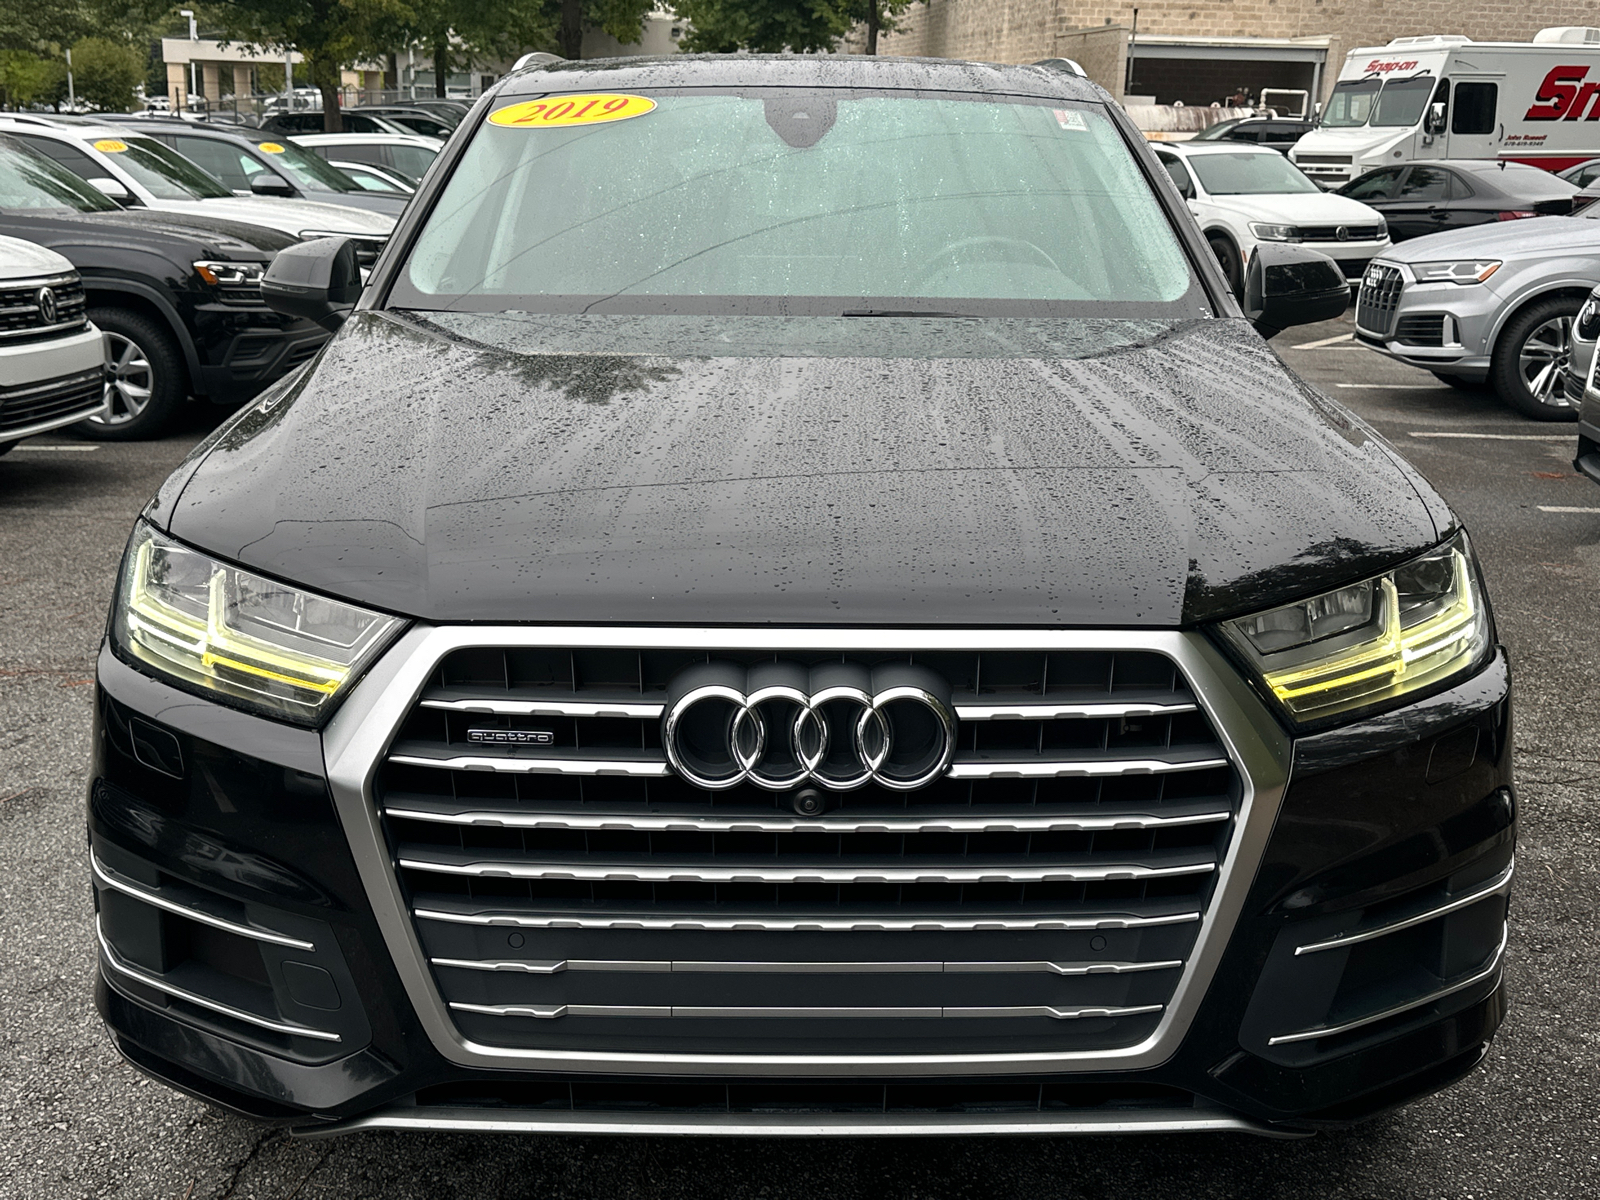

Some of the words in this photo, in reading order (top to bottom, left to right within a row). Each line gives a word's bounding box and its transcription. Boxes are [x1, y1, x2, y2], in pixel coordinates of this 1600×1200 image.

[1363, 59, 1419, 75] Snap-on
[511, 97, 630, 124] 2019
[471, 732, 549, 742] quattro
